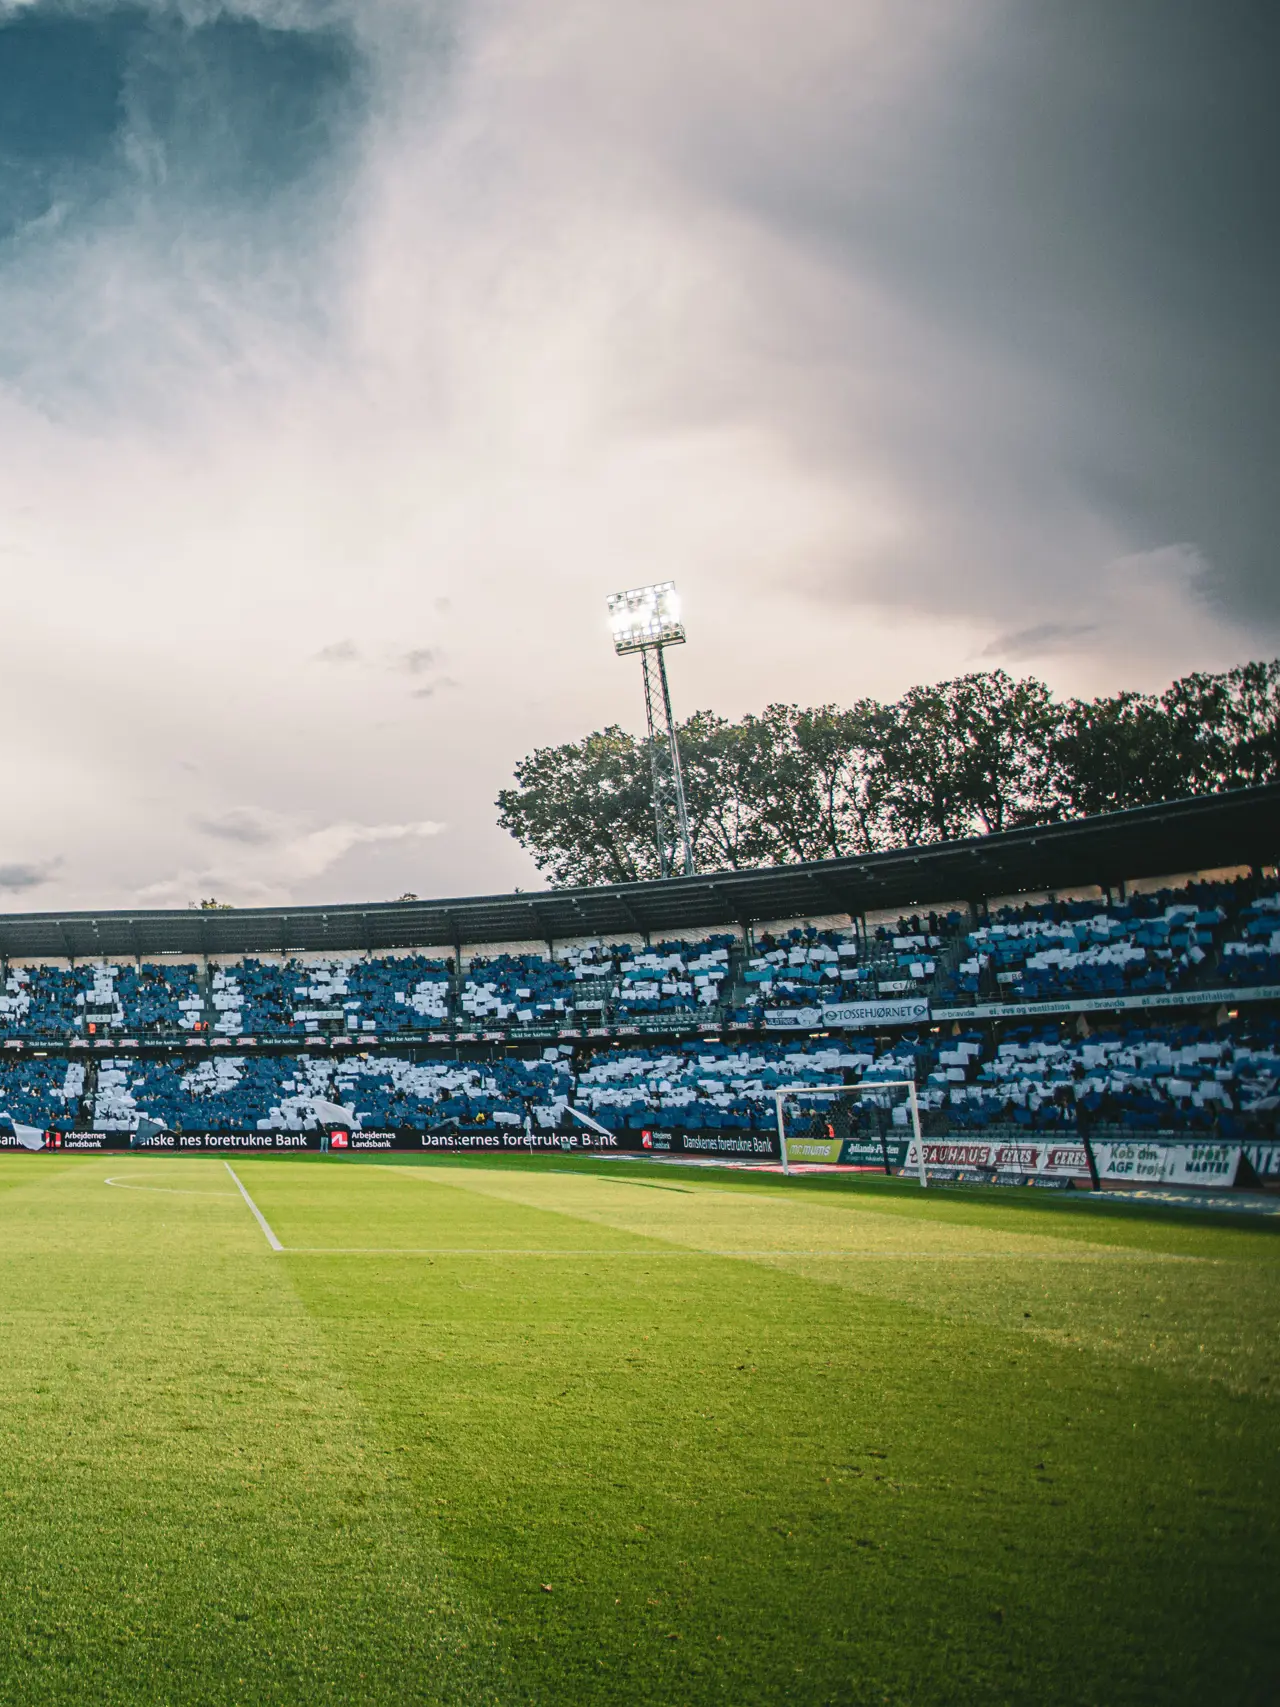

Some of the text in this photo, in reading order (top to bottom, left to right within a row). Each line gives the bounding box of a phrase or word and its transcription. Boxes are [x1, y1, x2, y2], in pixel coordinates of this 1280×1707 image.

[837, 1004, 912, 1020] TOSSEHJØRNET
[1028, 1004, 1070, 1012] ventilation
[64, 1131, 106, 1141] Arbejdernes
[204, 1133, 272, 1146] foretrukne
[275, 1134, 307, 1147] Bank
[351, 1131, 396, 1141] Arbejdernes
[64, 1140, 102, 1148] Landsbank
[351, 1140, 391, 1148] Landsbank
[683, 1134, 773, 1153] Danskernes foretrukne Bank
[921, 1146, 989, 1163] BAUHAUS
[1001, 1149, 1033, 1164] CERES
[1053, 1151, 1088, 1167] CERES
[1137, 1148, 1157, 1161] din
[1191, 1148, 1230, 1162] SPORT
[1106, 1161, 1134, 1174] AGF
[1184, 1161, 1230, 1174] MASTER
